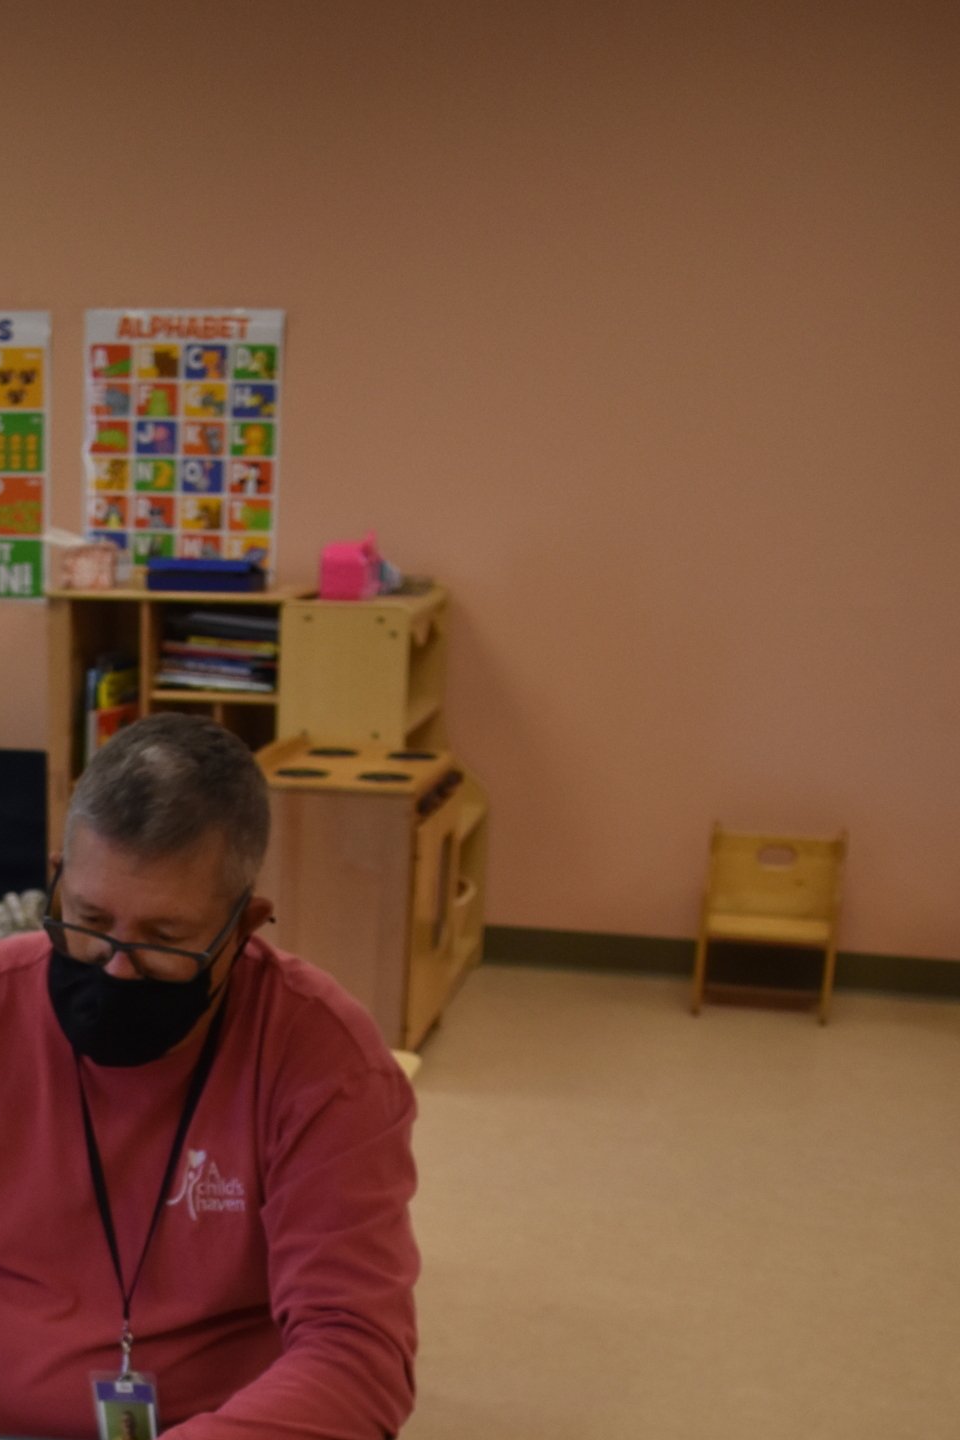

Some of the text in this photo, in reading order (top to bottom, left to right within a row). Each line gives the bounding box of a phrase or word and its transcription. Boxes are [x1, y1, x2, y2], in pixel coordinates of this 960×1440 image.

[117, 315, 251, 339] ALPHABET
[93, 347, 110, 369] A
[188, 348, 205, 370] C
[236, 347, 252, 369] D
[139, 385, 153, 406] F
[235, 386, 252, 407] H
[139, 423, 154, 444] J
[186, 424, 202, 444] K
[233, 424, 246, 444] L
[140, 461, 155, 480] N
[138, 536, 152, 555] V
[184, 537, 204, 556] W
